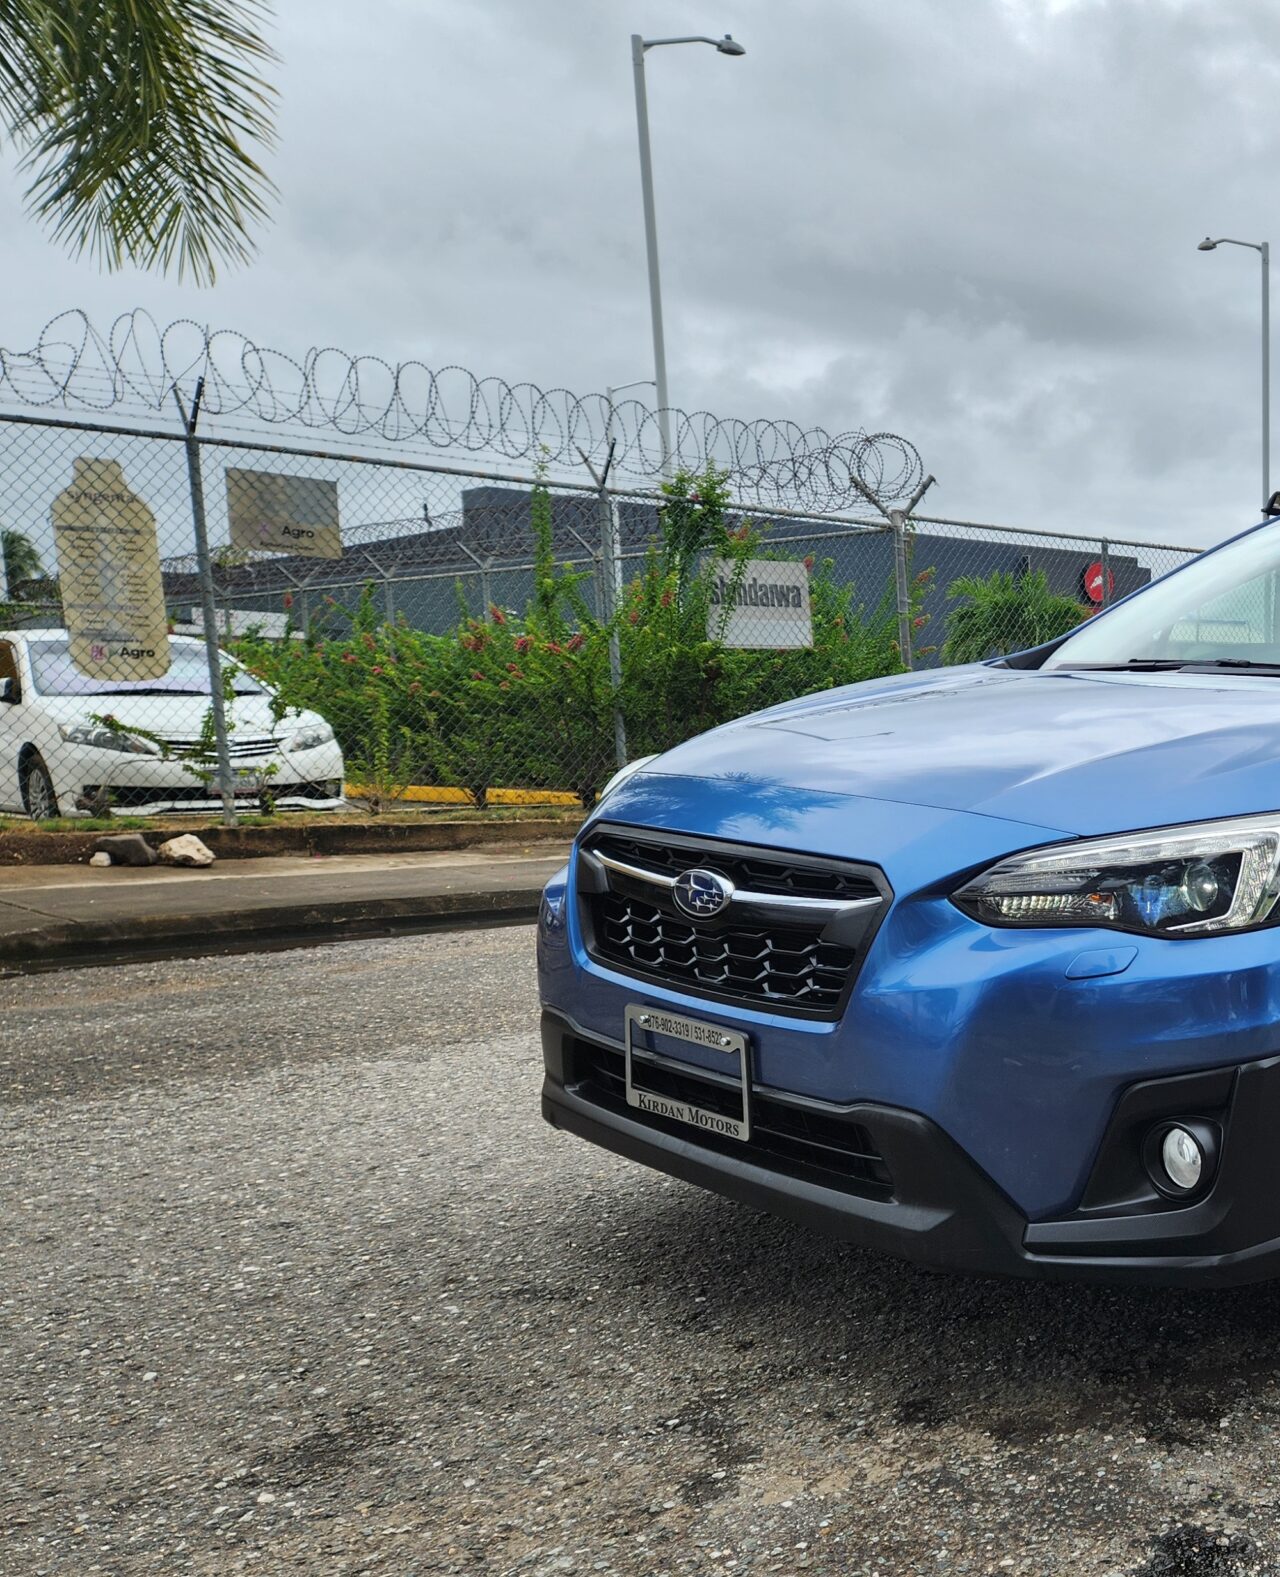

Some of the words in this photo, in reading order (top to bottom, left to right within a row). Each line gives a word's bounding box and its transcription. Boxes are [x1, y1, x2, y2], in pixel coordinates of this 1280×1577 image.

[281, 525, 315, 539] Agro
[711, 575, 802, 608] shndaiwa
[120, 646, 156, 660] Agro
[638, 1093, 684, 1120] KIRDAN
[687, 1107, 740, 1137] MOTORS
